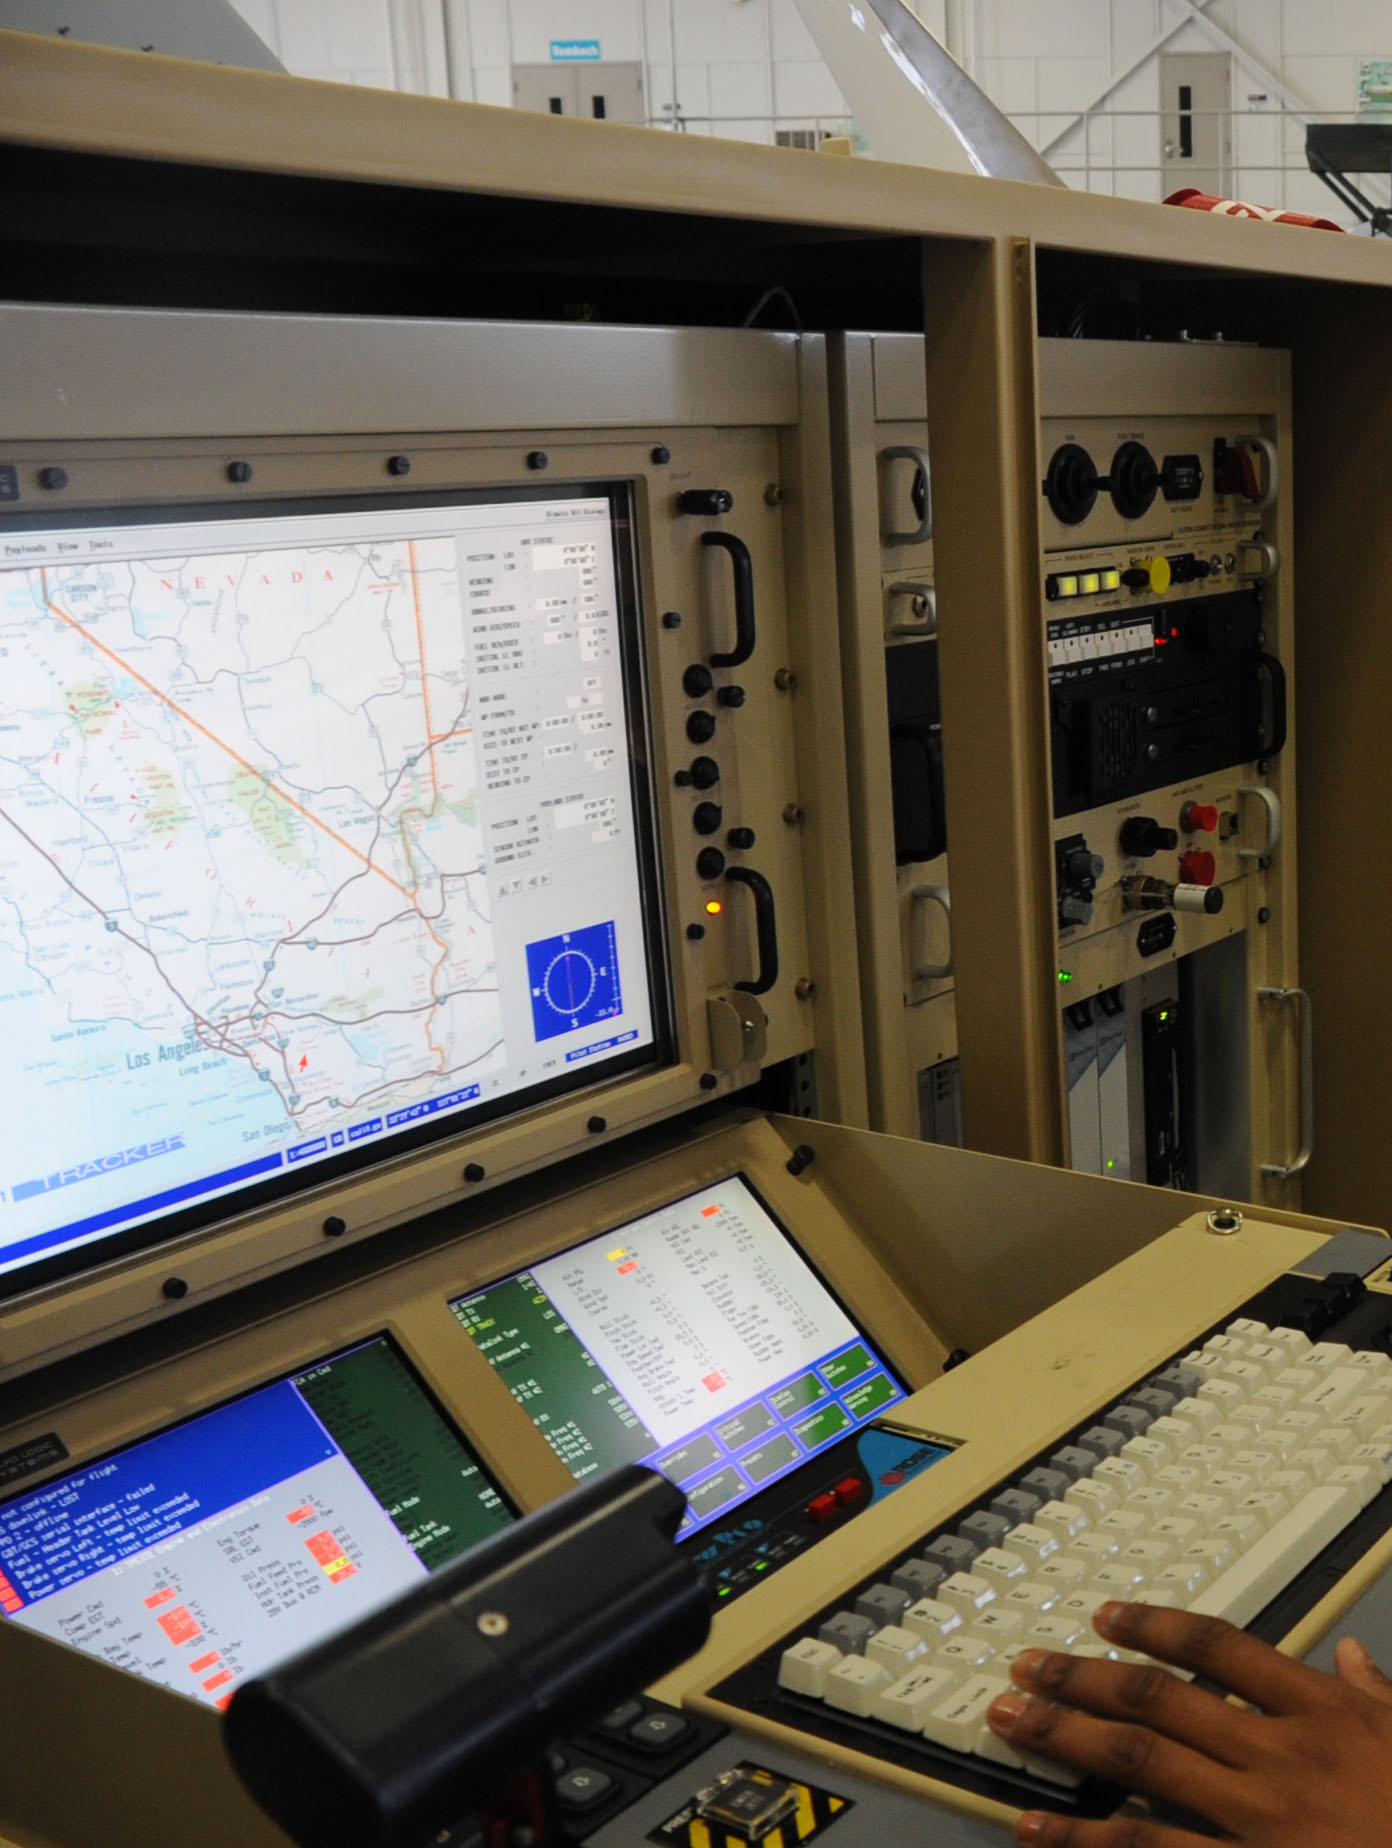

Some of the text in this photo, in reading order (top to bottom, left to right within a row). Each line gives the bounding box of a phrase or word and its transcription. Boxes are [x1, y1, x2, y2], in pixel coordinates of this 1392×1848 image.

[124, 1036, 209, 1073] Los Angeles
[41, 1131, 187, 1189] TRACKER
[20, 1484, 71, 1512] configured
[71, 1478, 86, 1489] for
[88, 1463, 119, 1481] flight
[7, 1491, 81, 1531] downlink LOST
[33, 1511, 70, 1531] offline
[73, 1502, 117, 1526] interface
[96, 1510, 123, 1528] Level
[15, 1562, 43, 1580] Brake
[44, 1549, 72, 1566] servo
[70, 1537, 95, 1553] Left
[126, 1510, 152, 1526] limit
[21, 1572, 51, 1590] Brake
[51, 1559, 79, 1575] servo
[78, 1545, 106, 1562] Right
[136, 1518, 162, 1535] limit
[410, 1534, 433, 1549] ngine
[27, 1583, 56, 1600] Power
[58, 1569, 85, 1586] servo
[118, 1540, 143, 1557] limit
